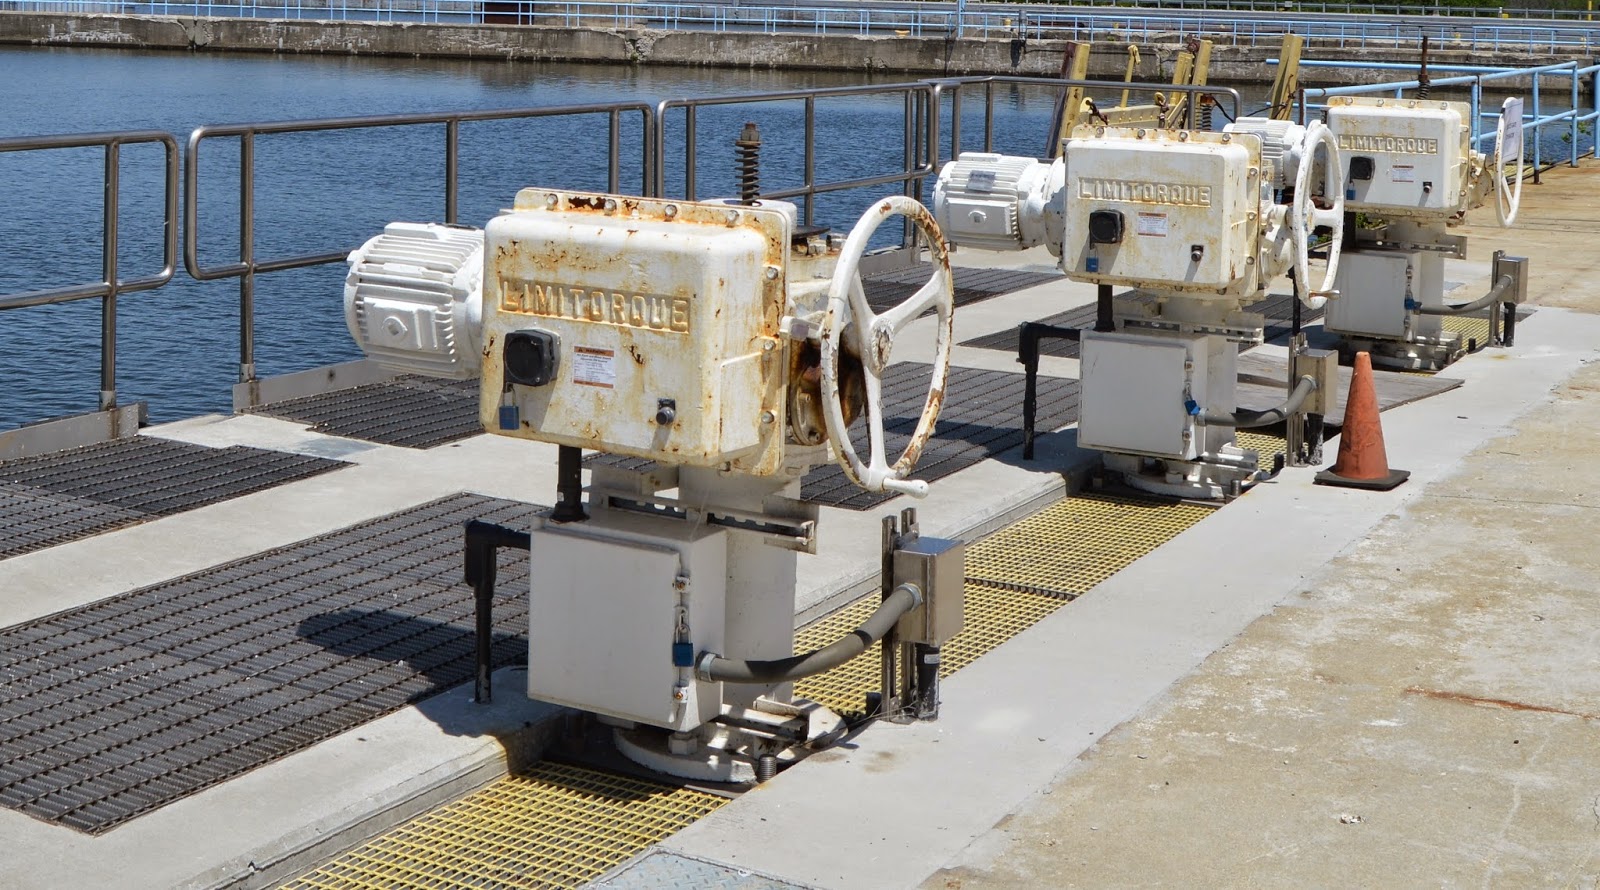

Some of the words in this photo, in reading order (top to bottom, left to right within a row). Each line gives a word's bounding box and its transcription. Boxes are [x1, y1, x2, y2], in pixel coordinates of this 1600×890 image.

[1340, 135, 1437, 154] LIMITORQUE
[1081, 179, 1211, 206] LIMITORQUE
[502, 280, 690, 332] LIMITORQUE
